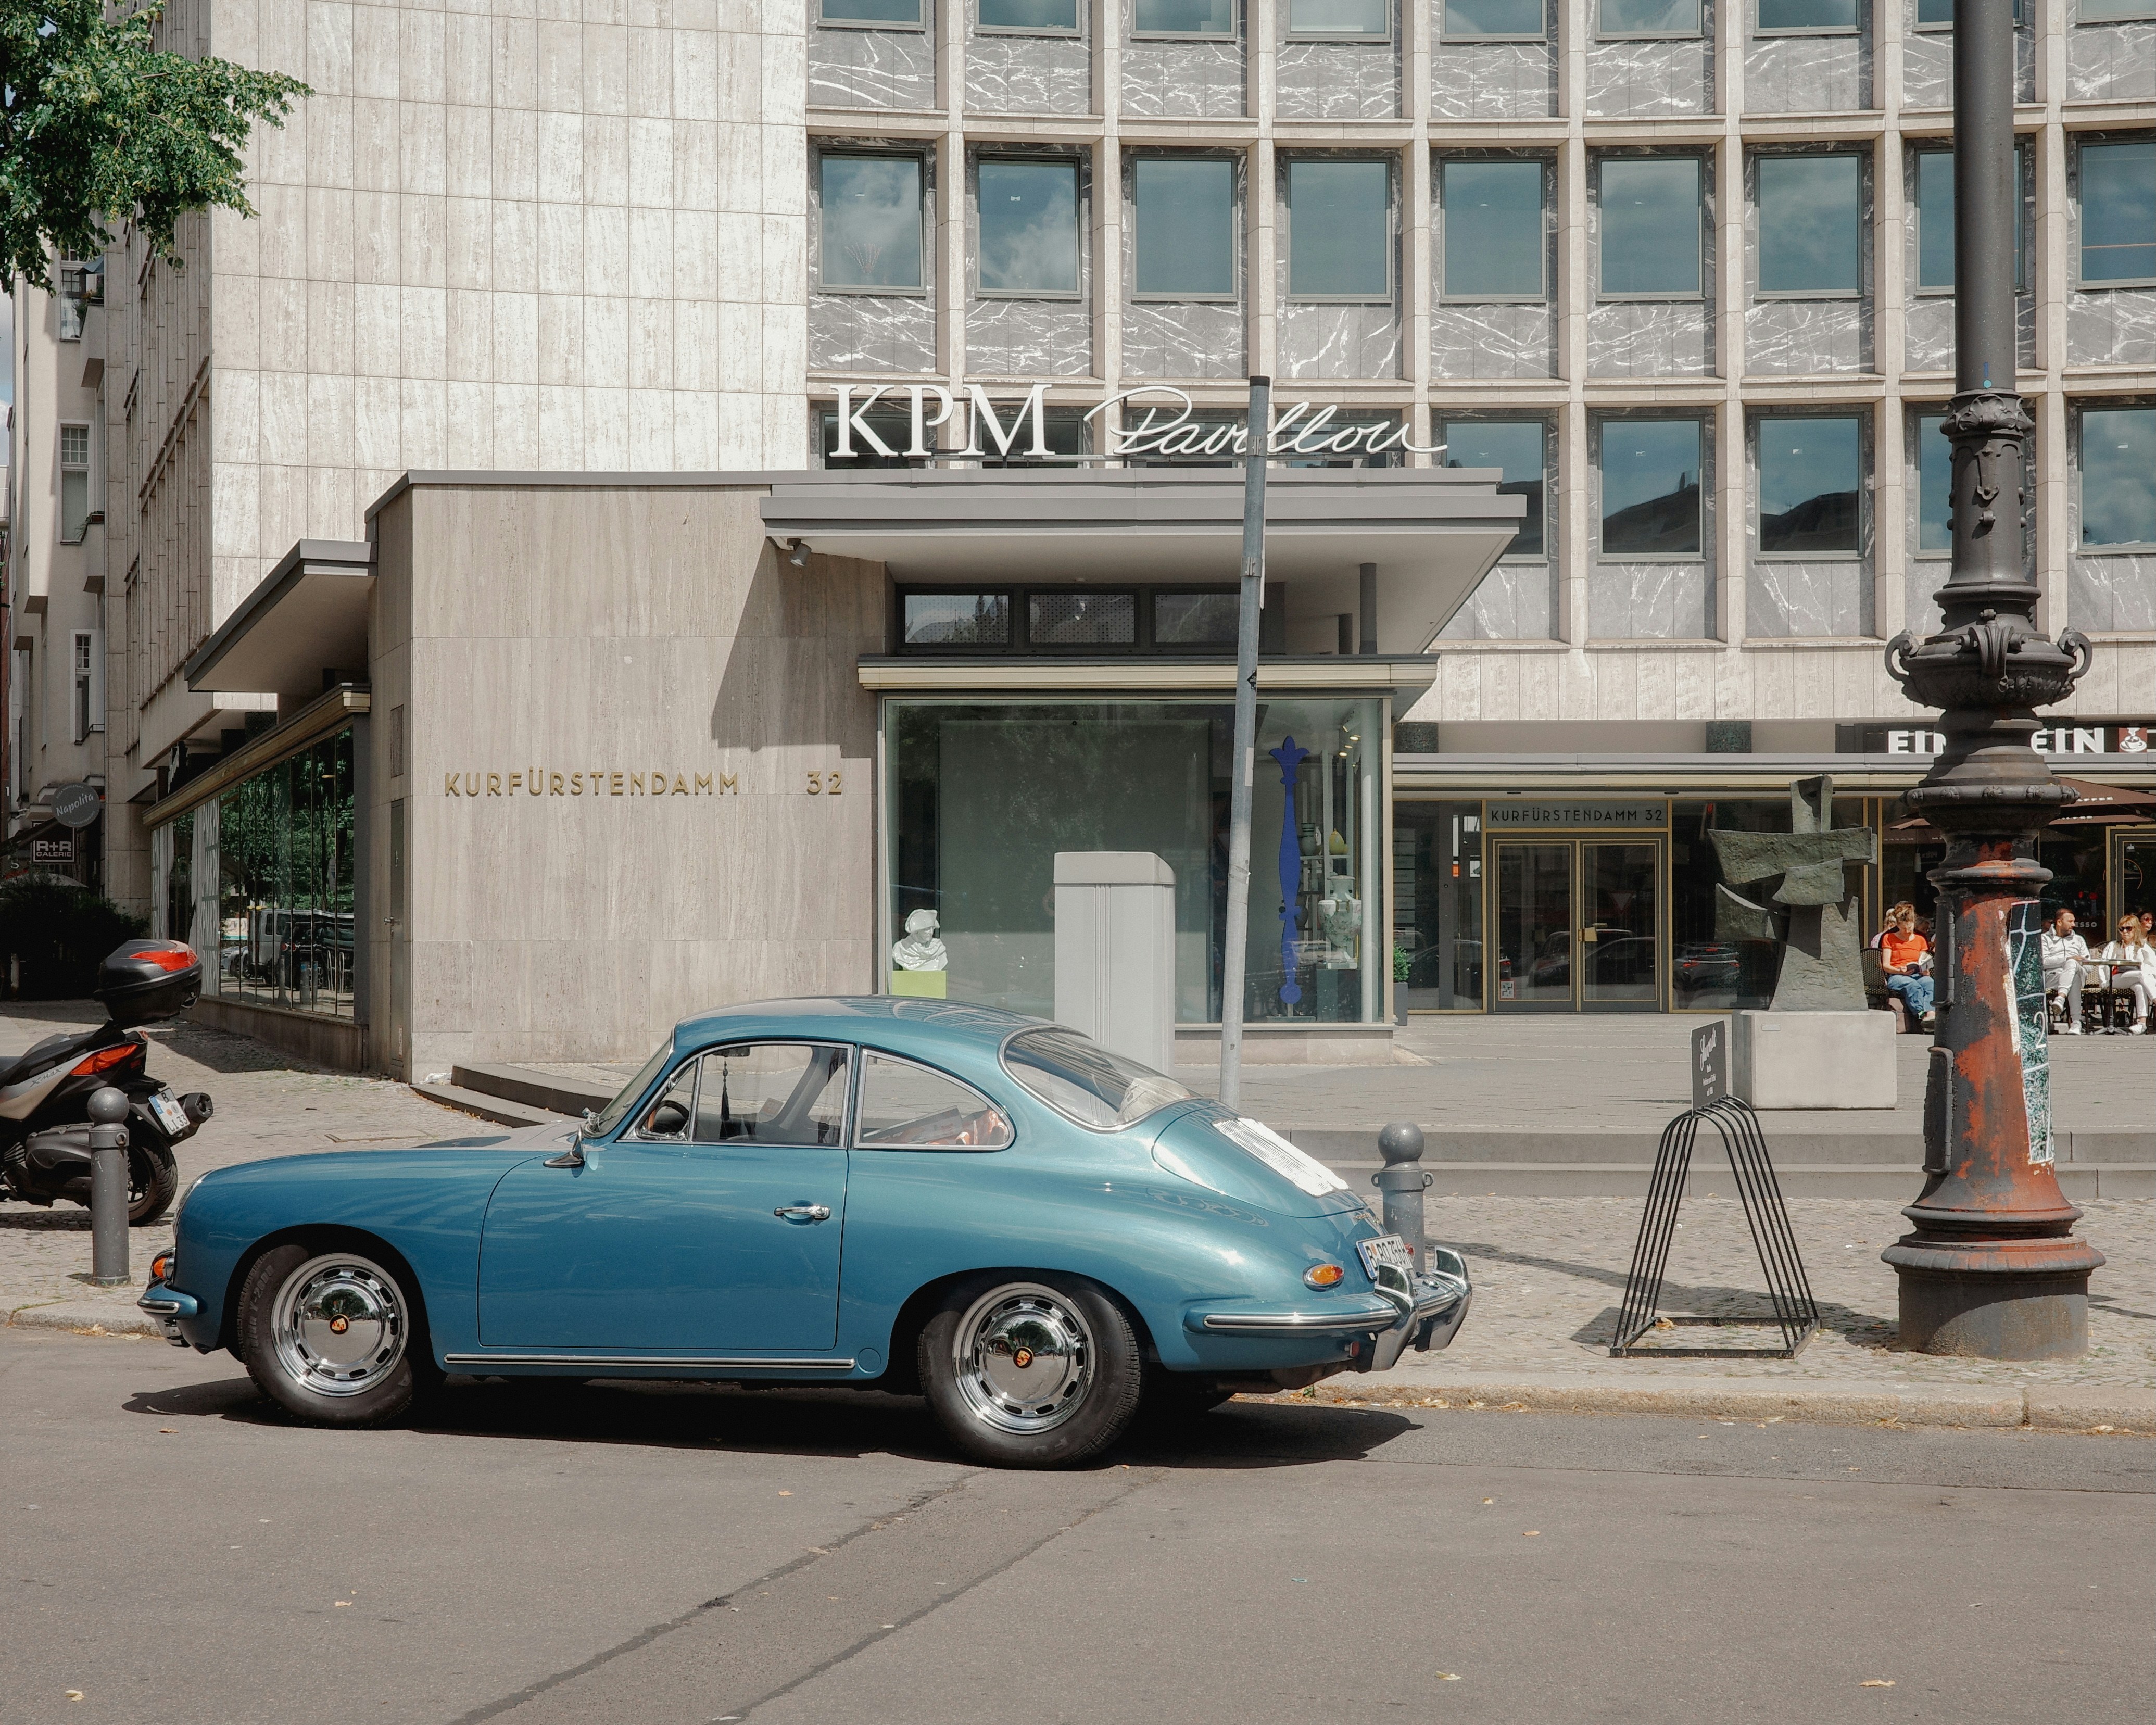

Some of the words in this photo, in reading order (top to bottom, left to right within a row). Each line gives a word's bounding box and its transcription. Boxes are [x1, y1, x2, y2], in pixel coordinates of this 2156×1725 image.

[828, 384, 1055, 457] KPM
[1083, 385, 1448, 456] Pavllon
[444, 766, 739, 797] KURFÜRSTENDAMM
[806, 771, 843, 796] 32
[56, 793, 94, 816] Napolita
[1491, 808, 1637, 821] KURFÜRSTENDAMM
[1645, 809, 1662, 821] 32
[36, 841, 72, 851] R+R
[161, 1092, 169, 1103] B
[176, 1114, 188, 1126] 33
[1365, 1245, 1378, 1271] B
